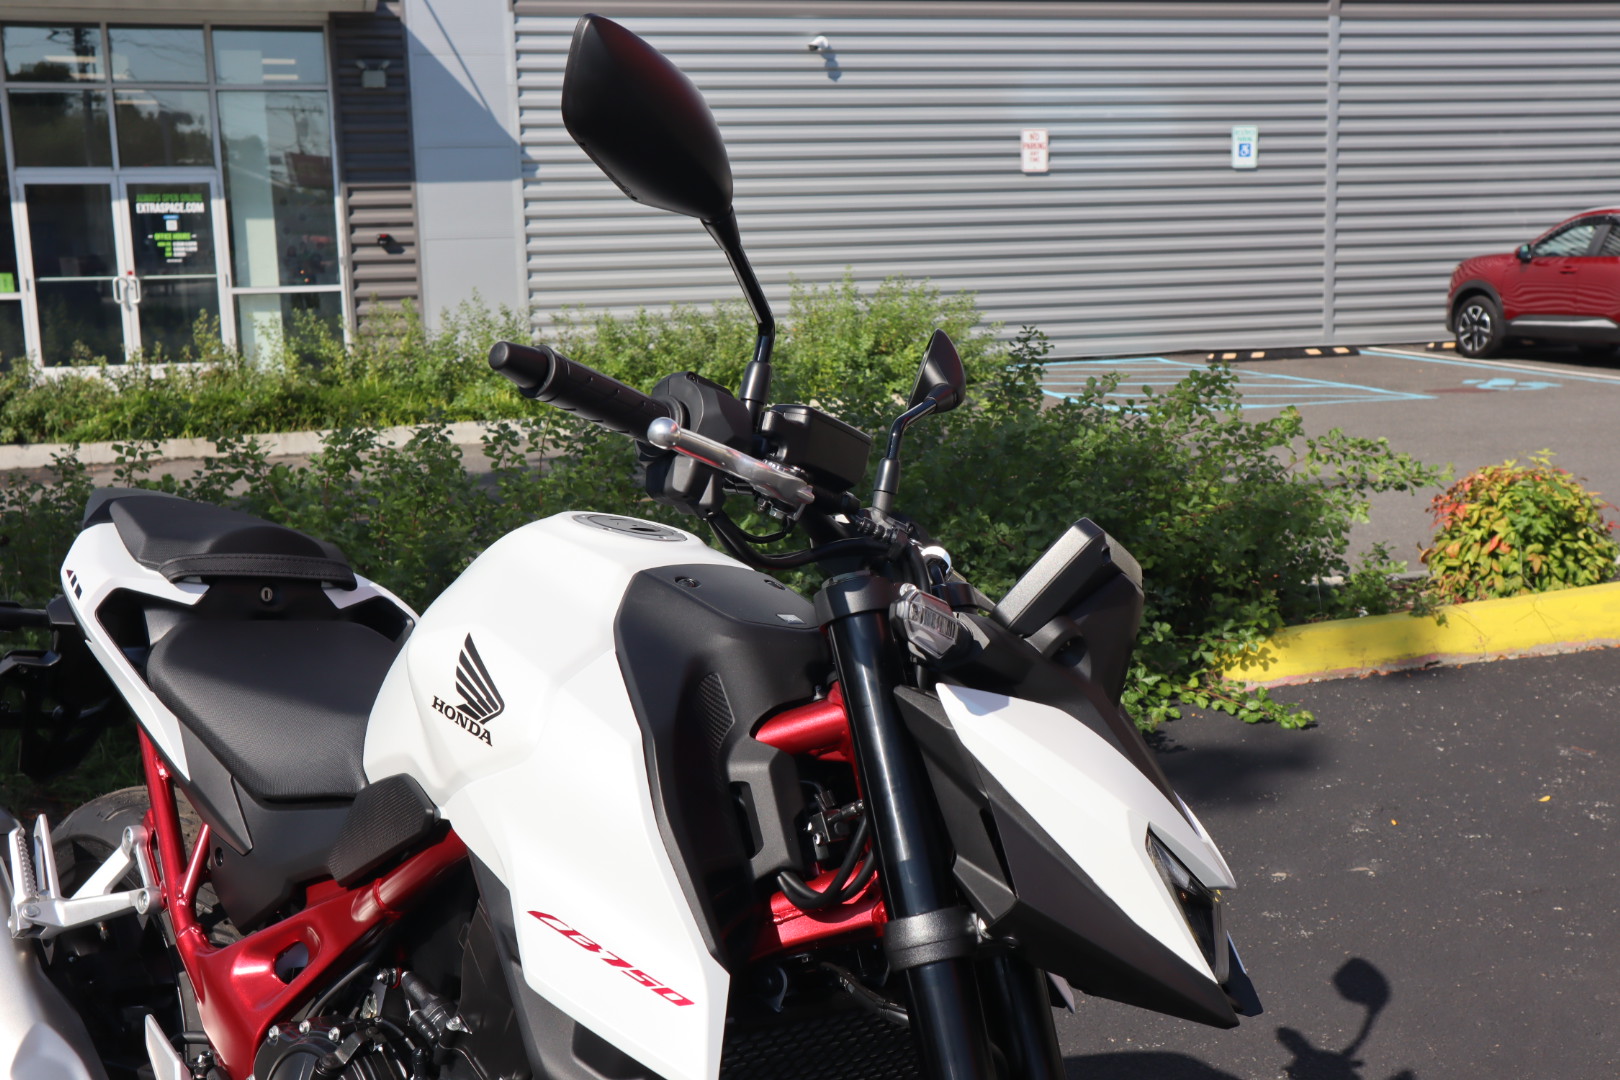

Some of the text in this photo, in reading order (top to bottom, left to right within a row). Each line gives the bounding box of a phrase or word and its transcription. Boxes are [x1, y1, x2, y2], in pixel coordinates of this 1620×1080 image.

[1029, 133, 1040, 141] NO
[1023, 142, 1047, 150] PARKING
[162, 193, 179, 202] OPEN
[136, 202, 205, 214] EXTRASPACE.COM
[431, 695, 493, 747] HONDA
[527, 910, 695, 1006] CB750
